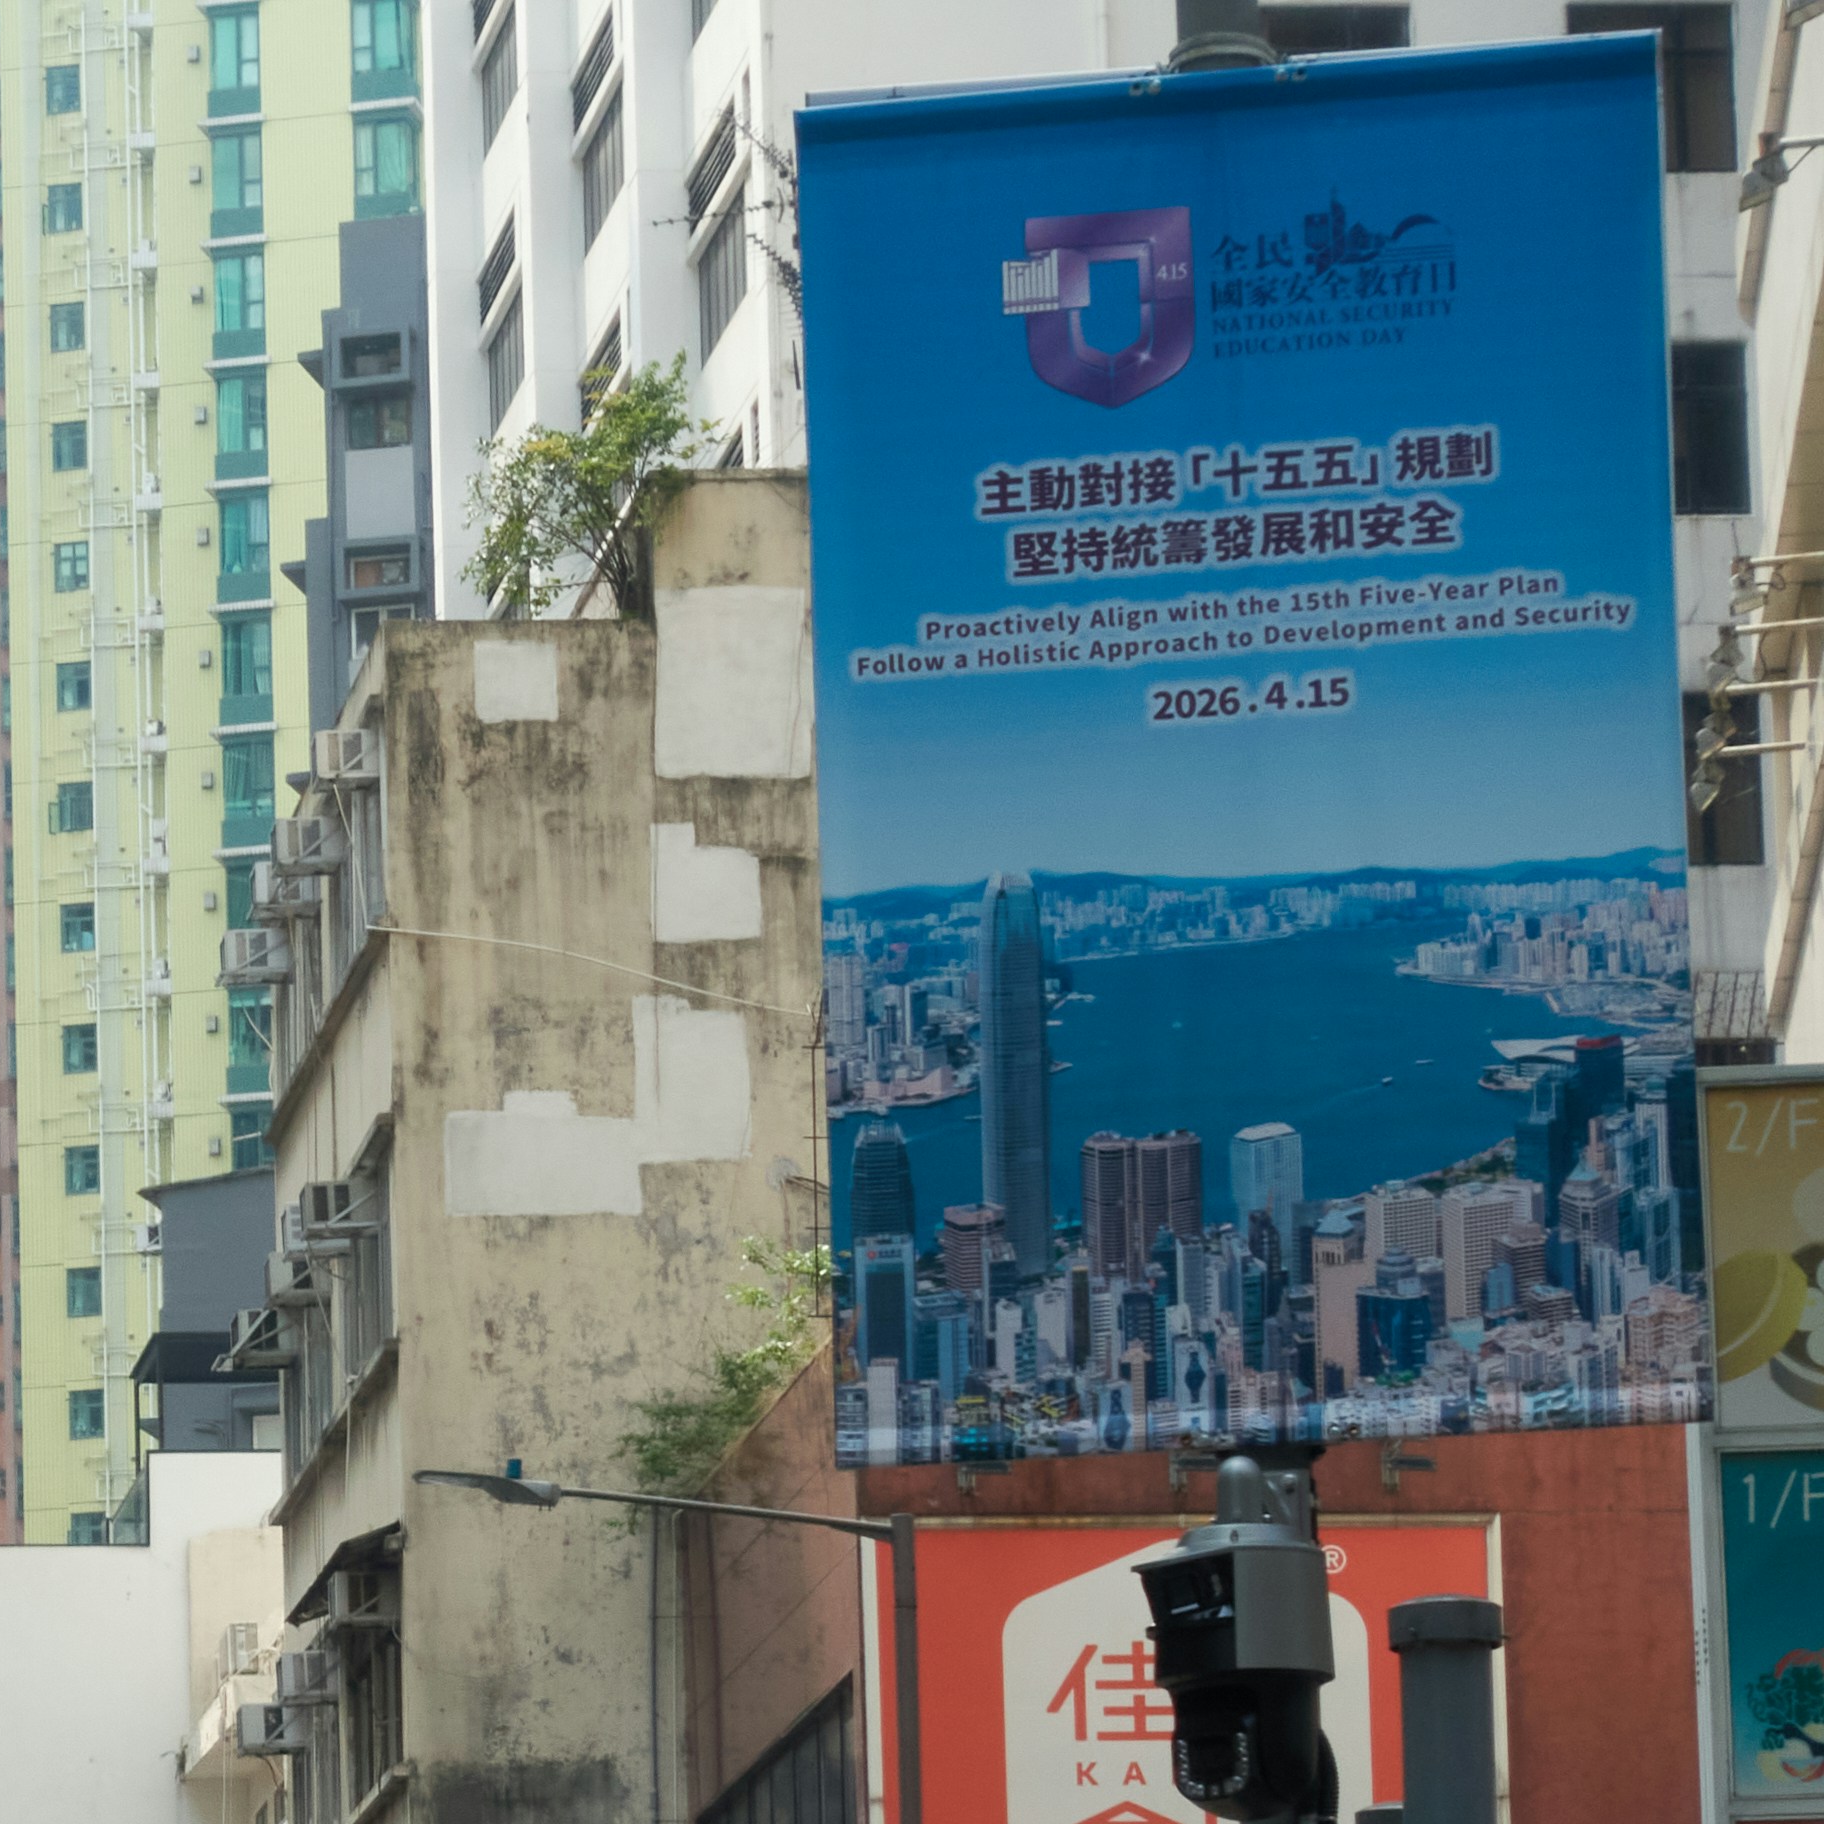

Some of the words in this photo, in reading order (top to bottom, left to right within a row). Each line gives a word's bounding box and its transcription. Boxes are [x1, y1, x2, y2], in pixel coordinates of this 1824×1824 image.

[1211, 231, 1293, 274] 全民
[1211, 260, 1457, 313] 國家安全教育日
[1212, 308, 1331, 336] NATIONAL
[1342, 299, 1454, 323] SECURITY
[1213, 332, 1349, 360] EDUCATION
[1363, 326, 1407, 345] DAY
[979, 426, 1493, 516] 主動對接「十五五」規劃
[1012, 500, 1456, 579] 堅持統籌發展和安全
[925, 611, 1081, 641] Proactively
[1089, 607, 1158, 632] Align
[1168, 601, 1228, 624] with
[1237, 596, 1280, 615] the
[1290, 588, 1350, 613] 15th
[1360, 579, 1490, 607] Five-Year
[1499, 574, 1559, 596] Plan
[857, 653, 945, 677] Follow
[954, 653, 969, 670] a
[977, 643, 1081, 668] Holistic
[1089, 632, 1219, 663] Approach
[1226, 629, 1254, 648] to
[1263, 614, 1446, 645] Development
[1455, 608, 1505, 631] and
[1514, 599, 1631, 627] Security
[1726, 1098, 1818, 1152] 2/F
